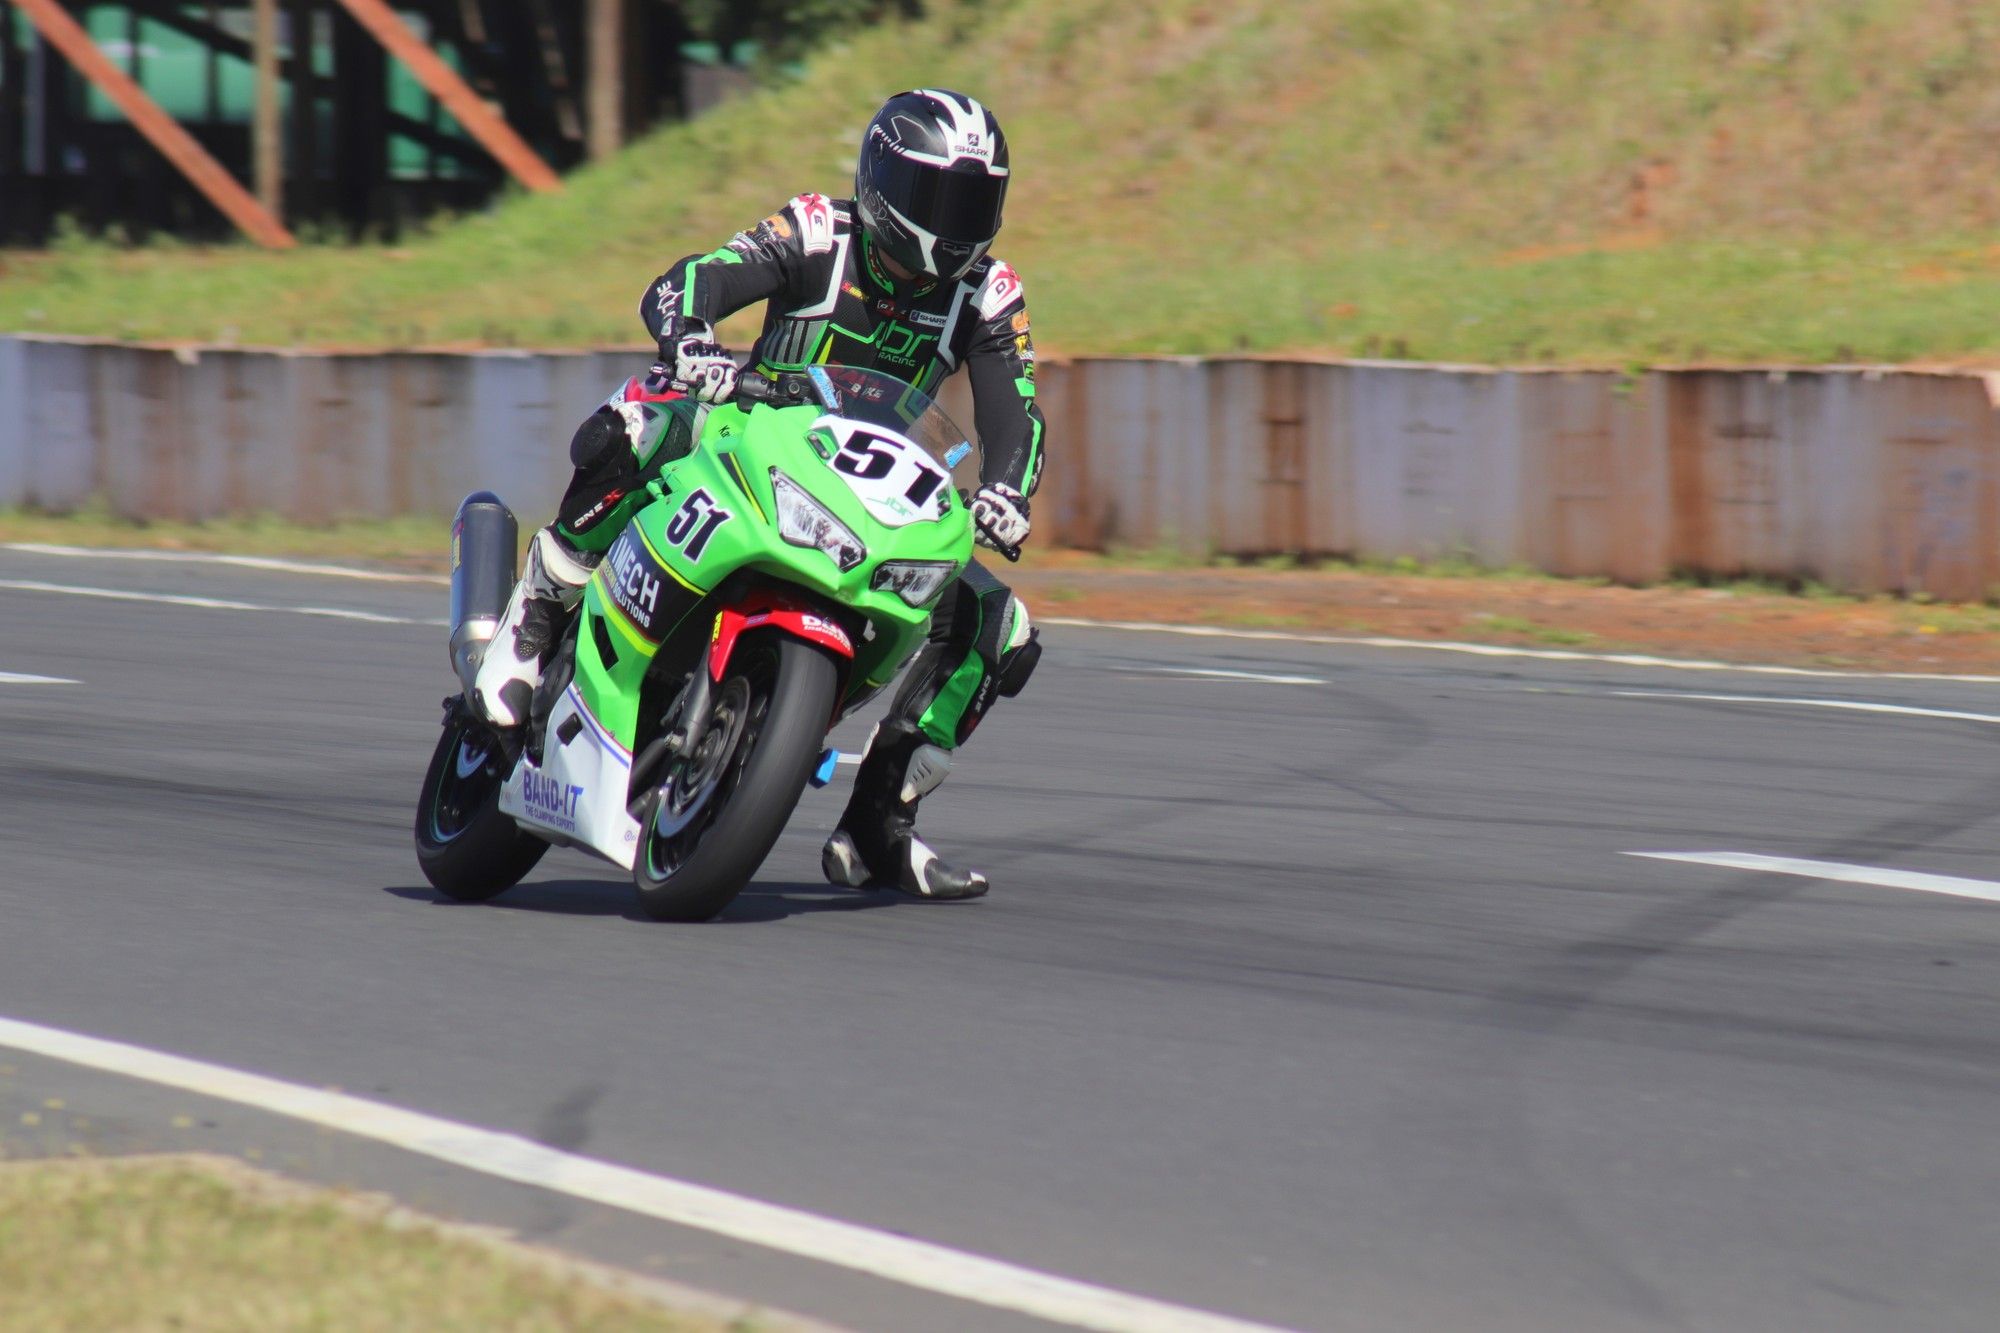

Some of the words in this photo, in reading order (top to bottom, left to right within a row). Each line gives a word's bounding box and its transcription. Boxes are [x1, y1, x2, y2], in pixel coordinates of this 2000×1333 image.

[954, 145, 988, 156] SHARK
[878, 352, 917, 367] RACING
[834, 430, 944, 508] 51
[666, 487, 731, 562] 51
[523, 770, 584, 818] BAND-IT
